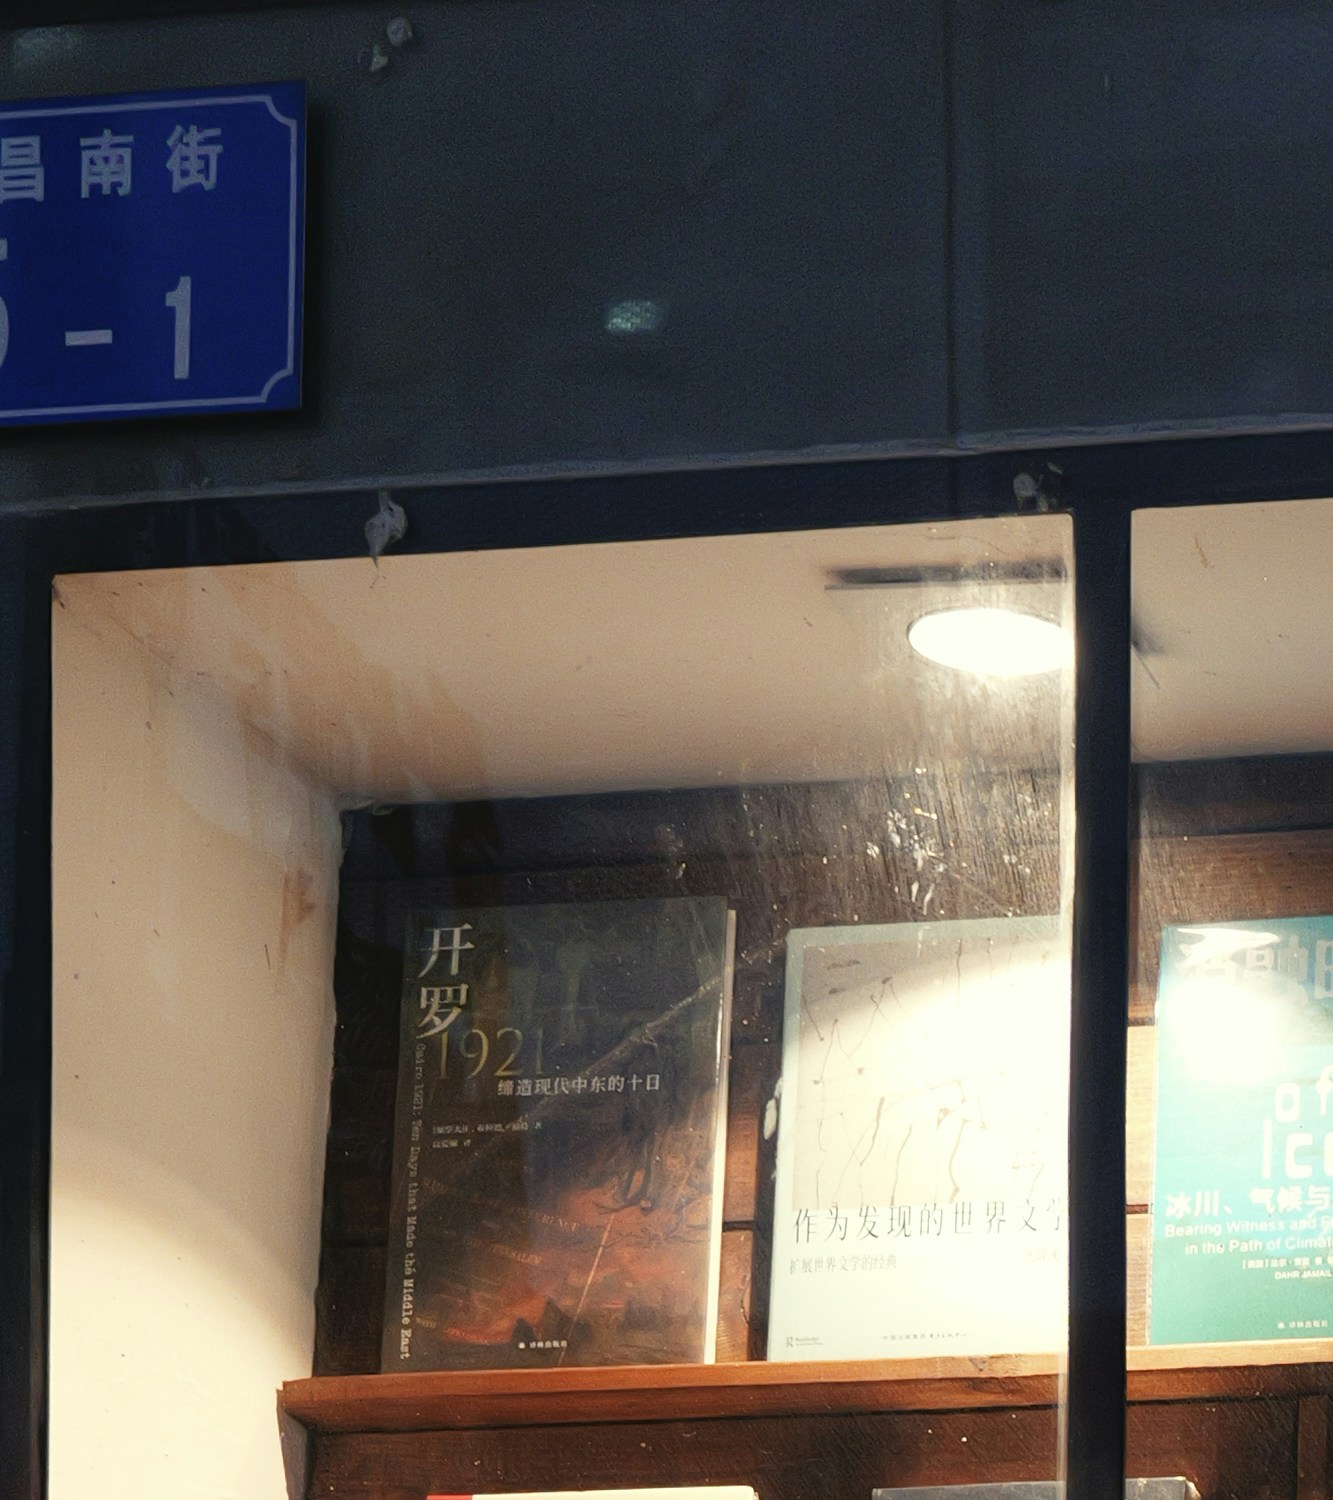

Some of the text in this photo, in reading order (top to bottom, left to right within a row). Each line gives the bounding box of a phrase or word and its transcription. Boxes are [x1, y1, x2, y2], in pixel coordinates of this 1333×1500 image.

[416, 922, 475, 1039] 开罗
[437, 1026, 545, 1080] 1921
[497, 1073, 660, 1097] 缔造现代中东的十日
[793, 1198, 1064, 1244] 作为发现的世界文学
[1165, 1221, 1223, 1239] Bearing
[1226, 1219, 1285, 1233] Witness
[789, 1254, 898, 1275] 扩展世界文学的经典
[1184, 1244, 1199, 1256] in
[1202, 1241, 1225, 1255] the
[1229, 1240, 1264, 1254] Path
[1266, 1238, 1283, 1251] of
[400, 1278, 415, 1360] Middle East
